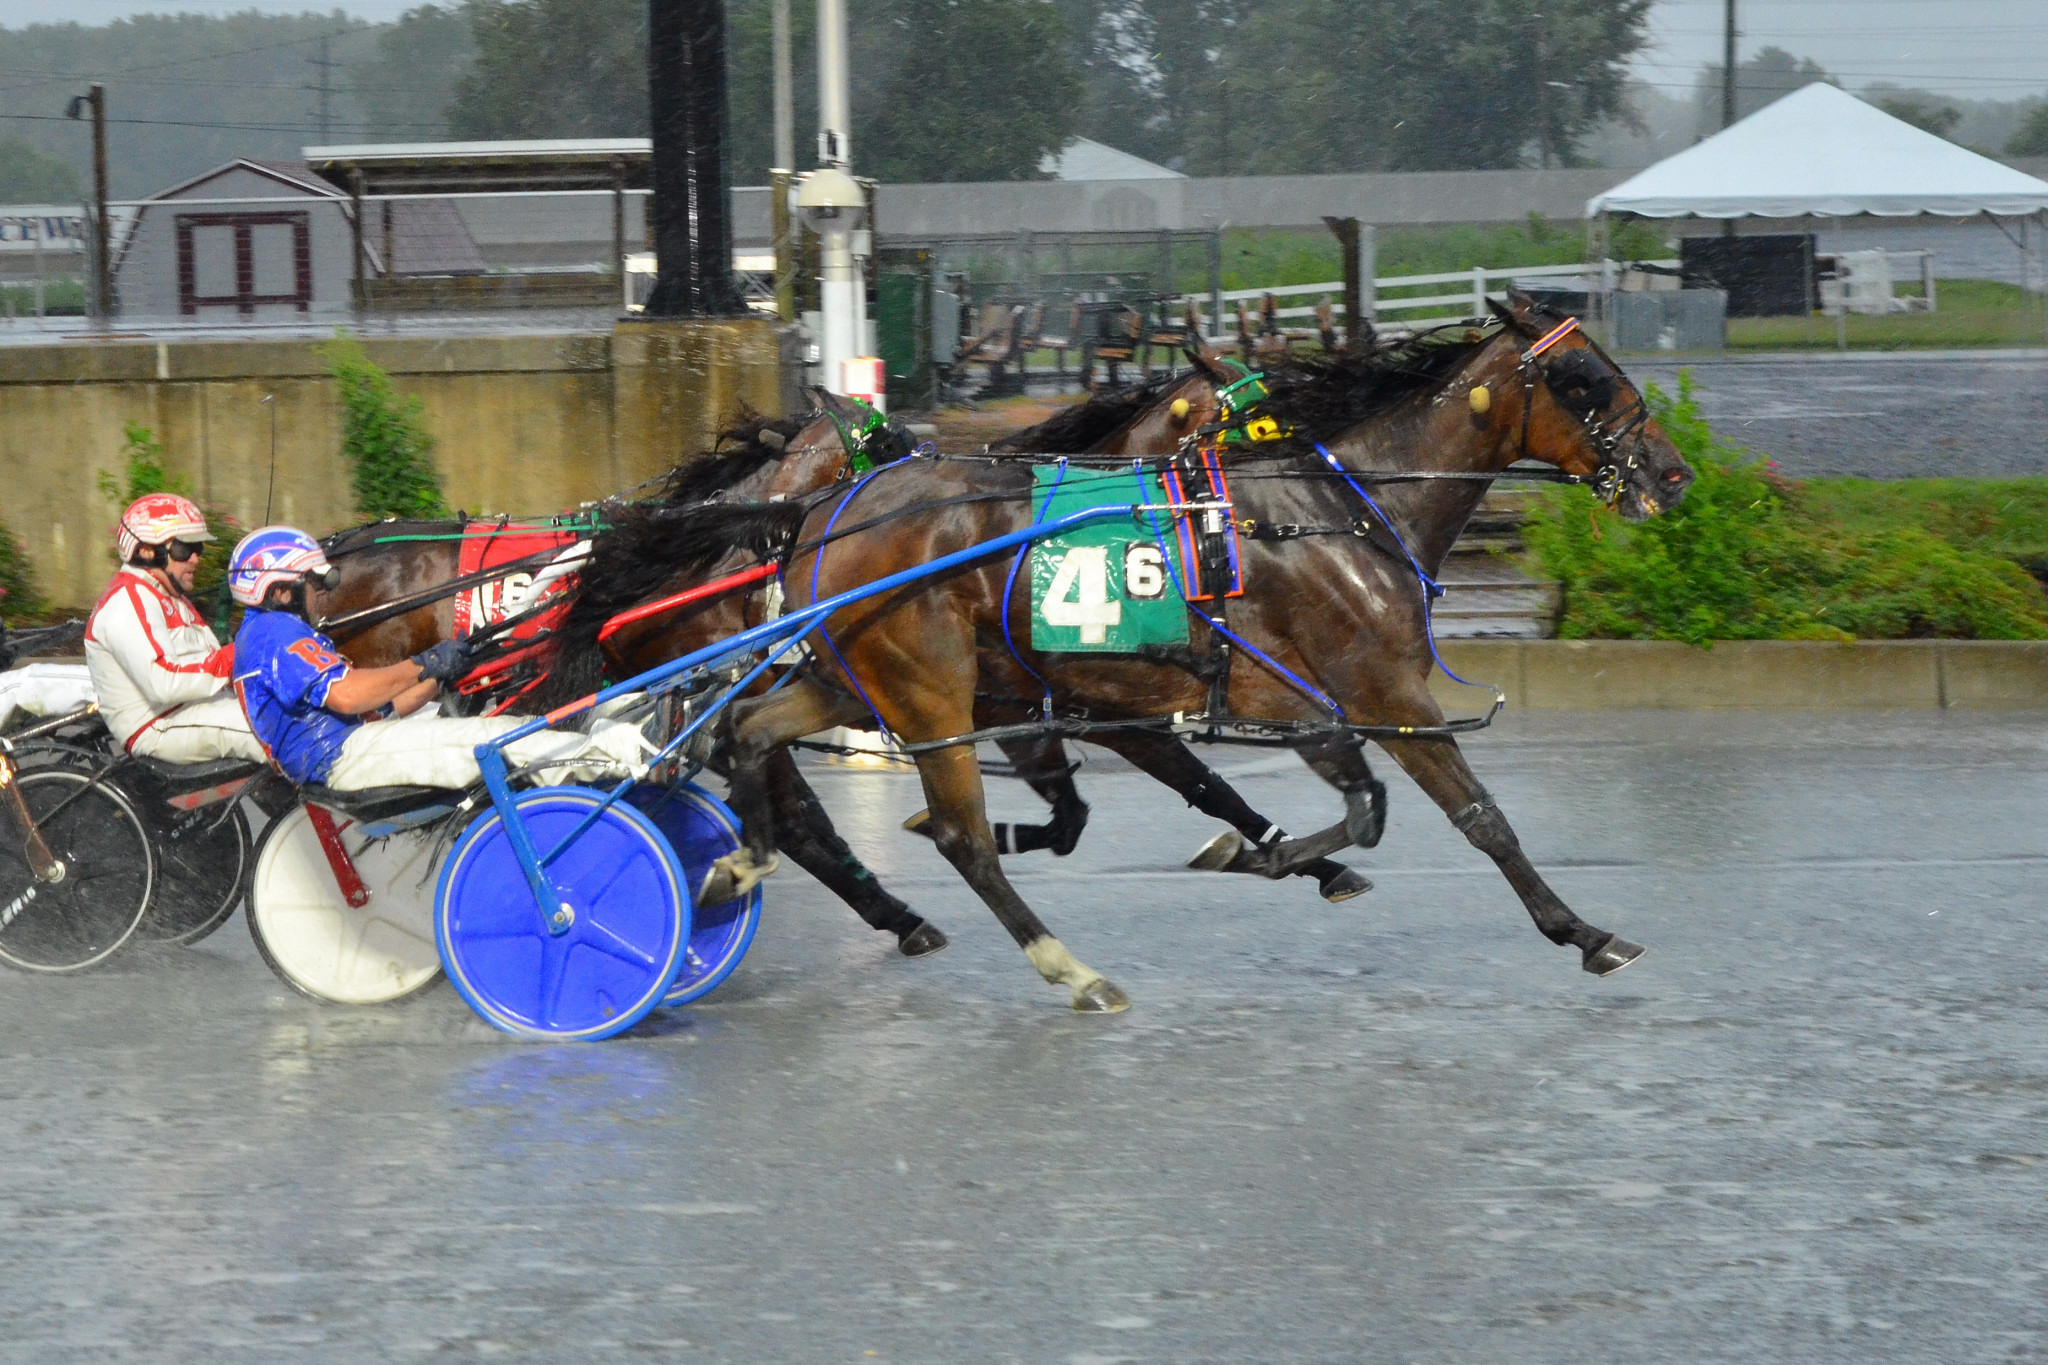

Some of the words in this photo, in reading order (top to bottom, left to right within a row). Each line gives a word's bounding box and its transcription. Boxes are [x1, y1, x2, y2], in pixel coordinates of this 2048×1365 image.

[1040, 546, 1121, 644] 4
[1126, 547, 1162, 596] 6
[287, 637, 341, 673] B
